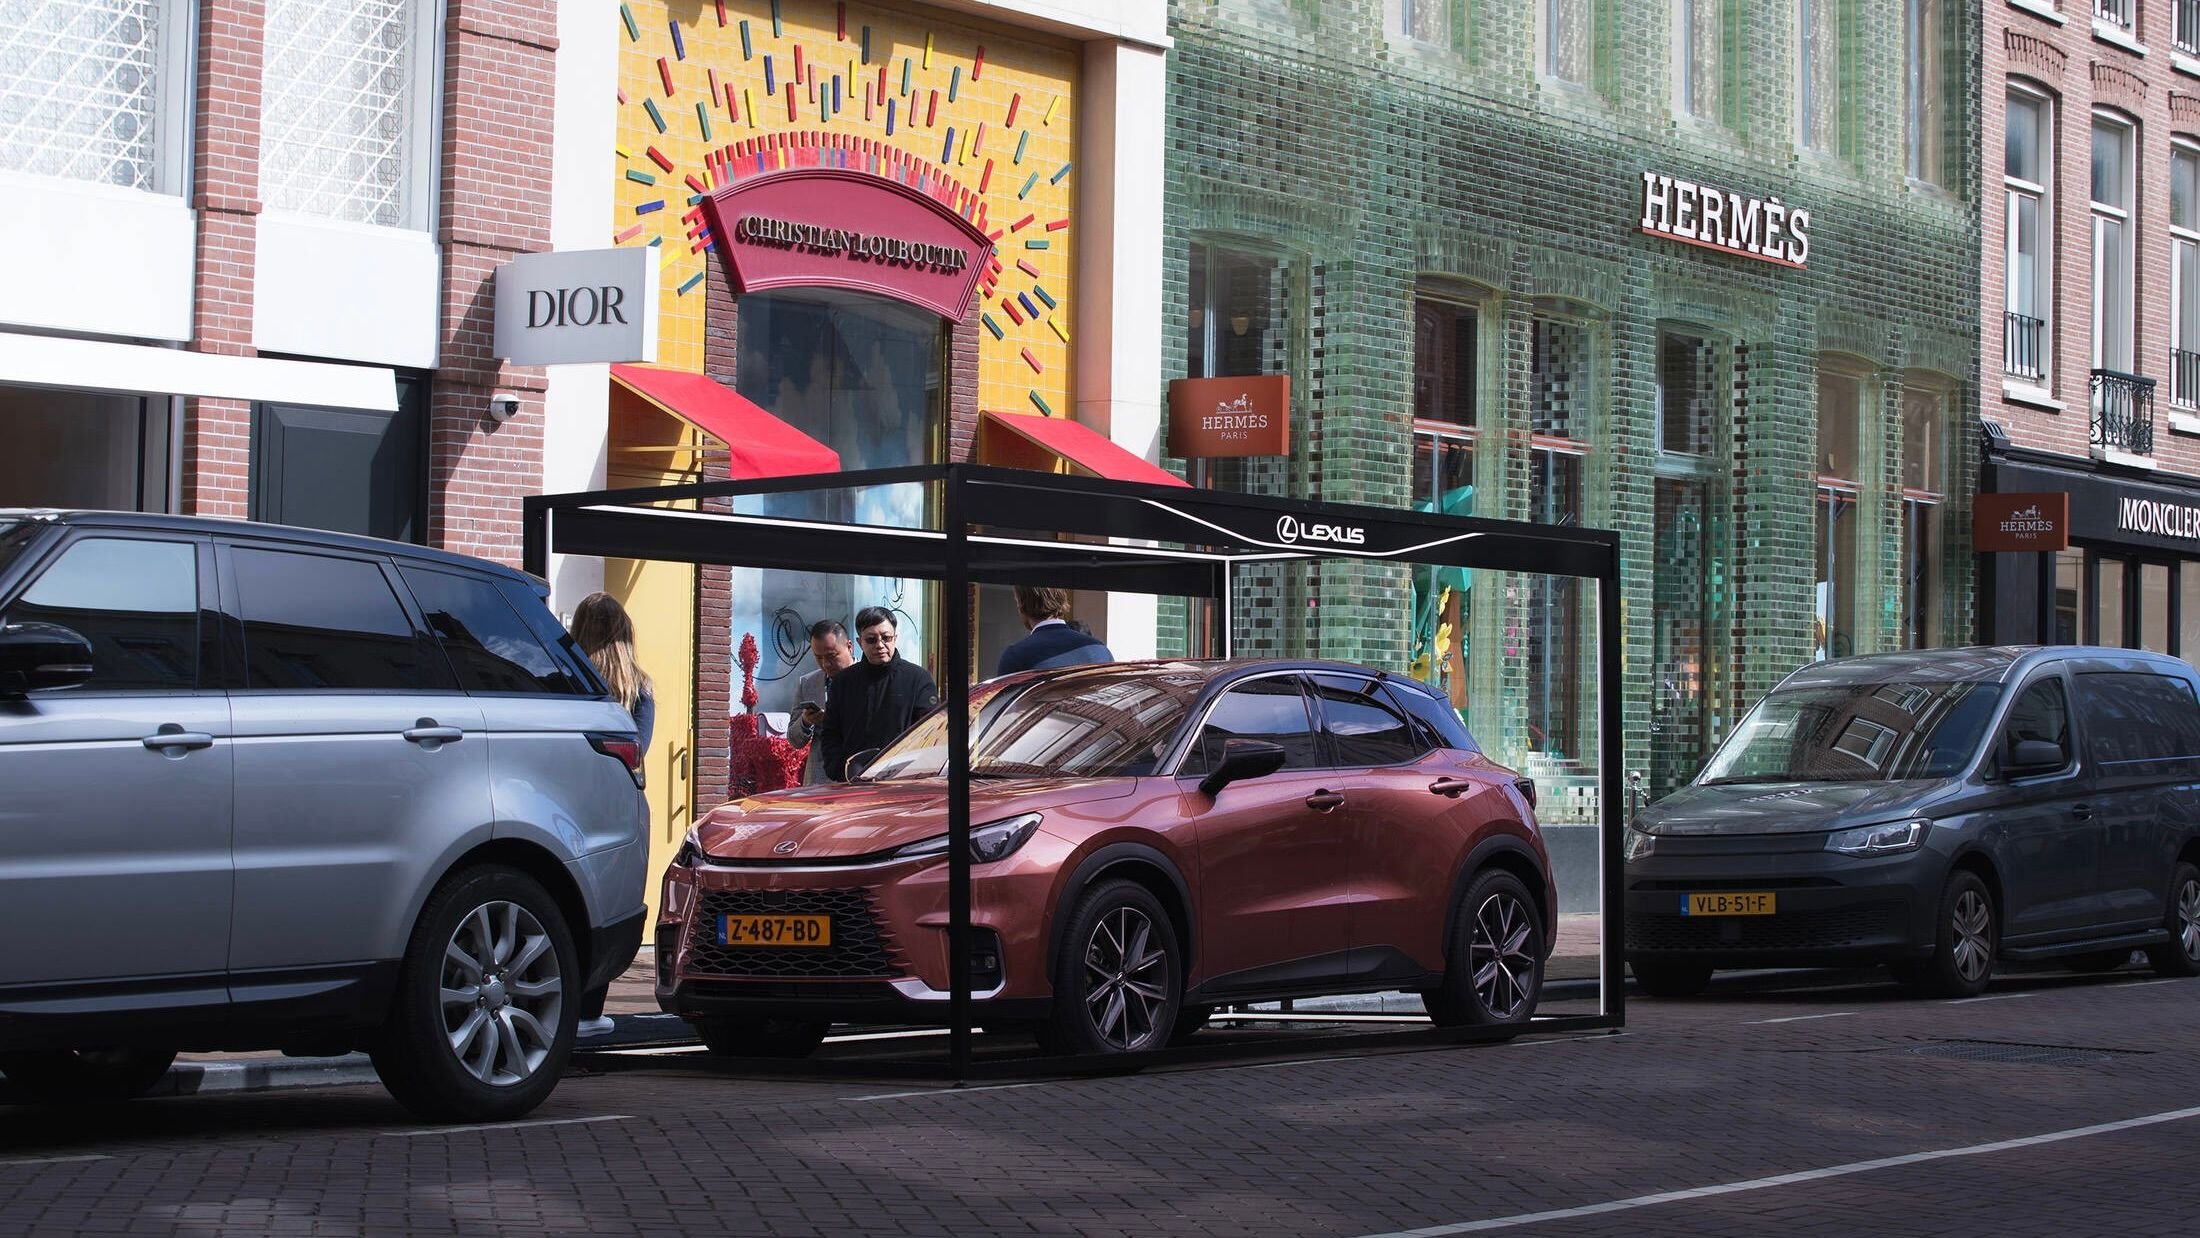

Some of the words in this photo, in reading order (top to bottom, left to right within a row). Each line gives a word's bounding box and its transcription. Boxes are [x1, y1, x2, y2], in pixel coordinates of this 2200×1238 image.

[1641, 171, 1810, 265] HERMÈS
[744, 214, 850, 251] CHRISTIAN
[856, 232, 969, 270] LOUBOUTIN
[525, 285, 628, 329] DIOR
[1201, 413, 1268, 430] HERMÈS
[1220, 431, 1248, 440] PARIS
[2000, 520, 2053, 532] HERMÈS
[2118, 496, 2200, 539] MONCLER
[1300, 522, 1365, 544] LEXUS
[2015, 532, 2037, 540] PARIS
[1696, 895, 1767, 913] VLB-51-F
[731, 919, 820, 941] Z-487-BD
